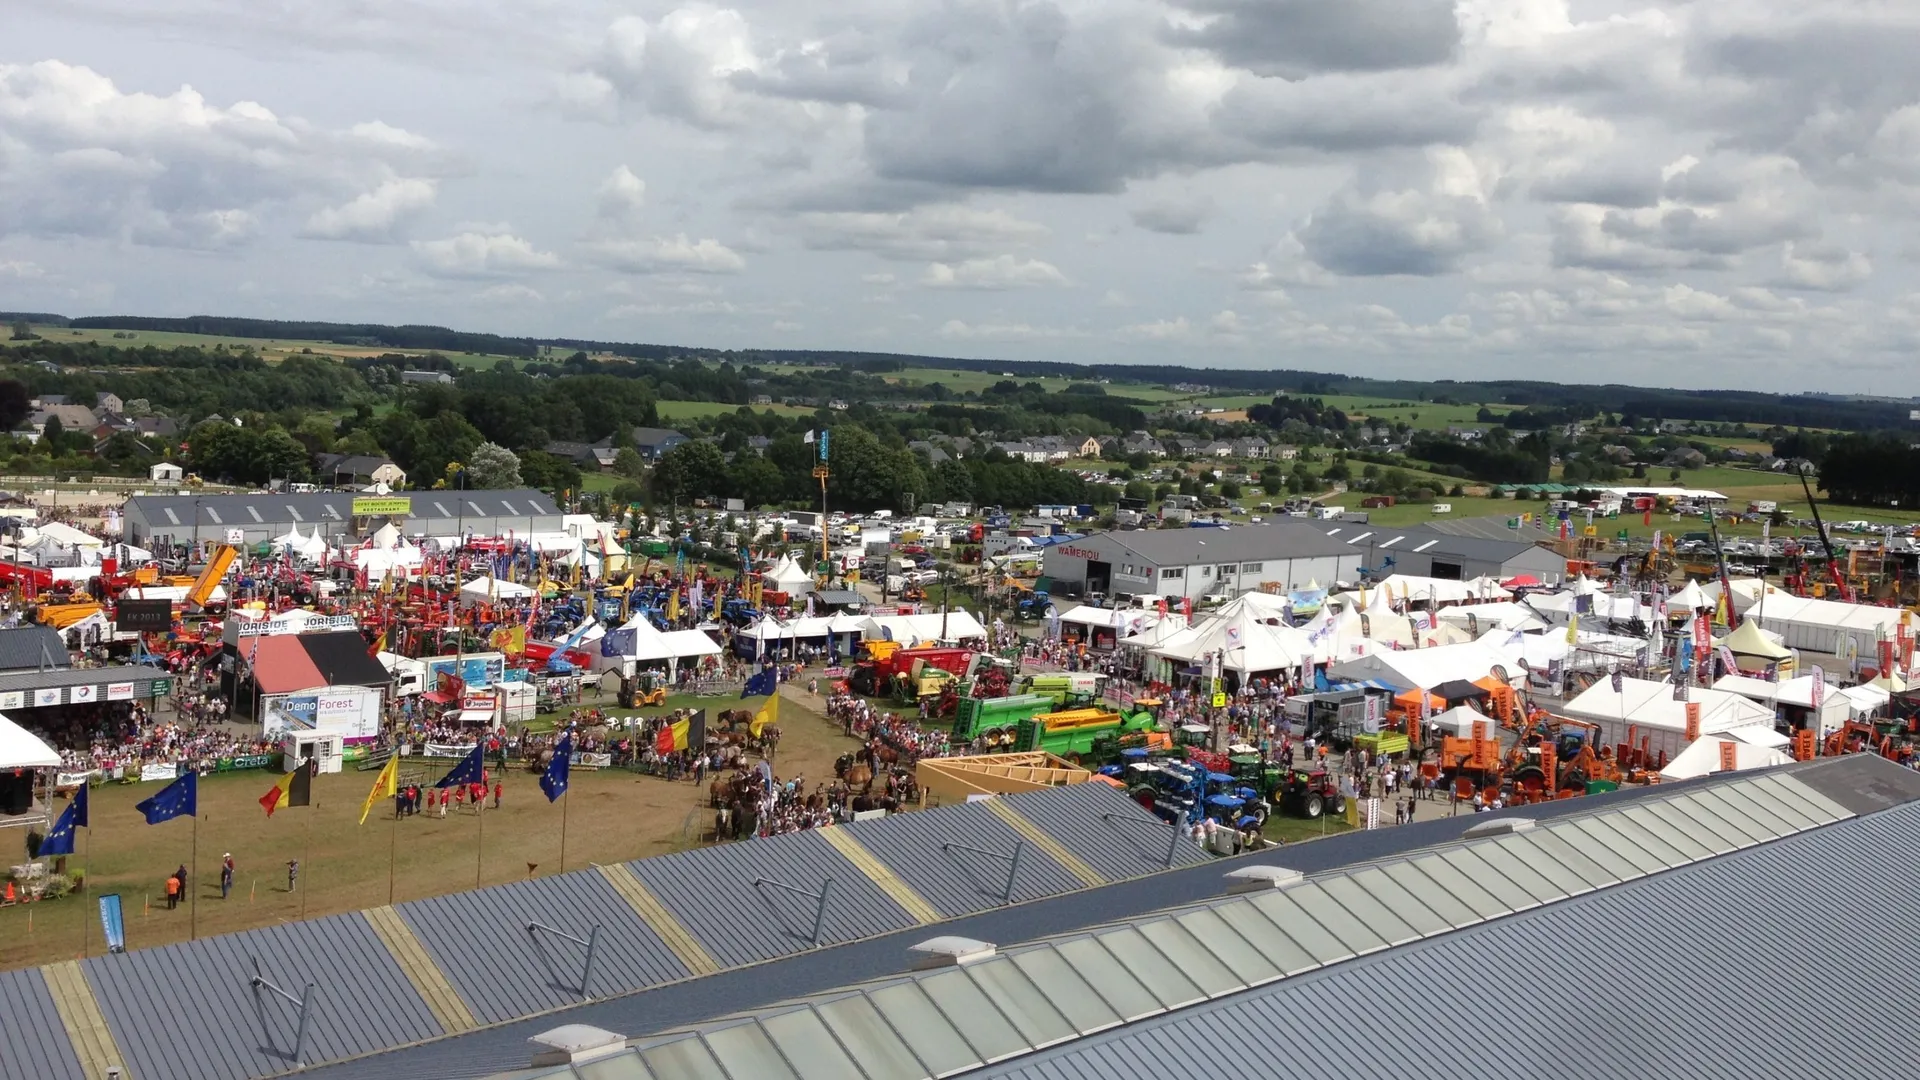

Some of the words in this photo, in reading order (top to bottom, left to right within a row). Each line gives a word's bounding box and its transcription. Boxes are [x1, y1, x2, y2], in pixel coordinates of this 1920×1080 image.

[1057, 546, 1100, 561] WAMEROU
[140, 613, 161, 621] 2013
[303, 616, 354, 626] JORISIDE
[239, 620, 288, 631] JORISIDE
[286, 701, 316, 711] Demo
[319, 699, 353, 709] Forest
[234, 755, 269, 768] Creta
